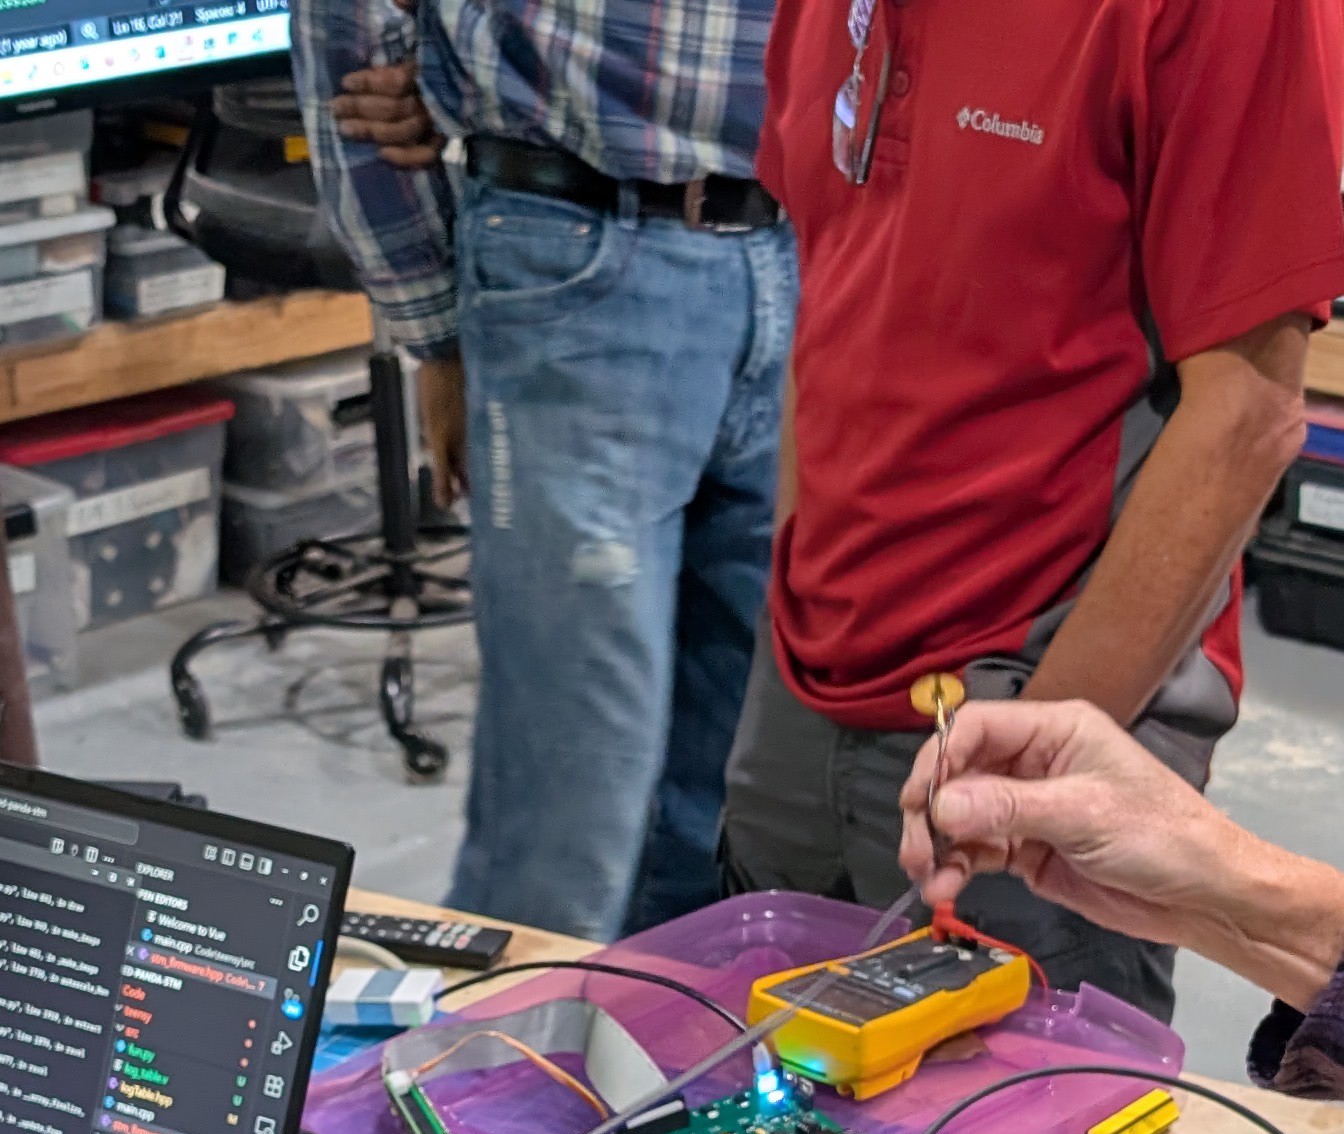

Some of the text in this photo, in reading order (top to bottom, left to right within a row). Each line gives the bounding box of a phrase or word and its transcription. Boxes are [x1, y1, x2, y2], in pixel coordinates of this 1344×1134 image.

[13, 35, 38, 55] year
[39, 30, 67, 49] ago)
[971, 109, 1044, 145] Columbia
[135, 862, 174, 881] EXPLORER
[154, 893, 188, 910] EDITORS
[156, 913, 227, 941] Welcome to Vue
[153, 933, 193, 954] main.cpp
[120, 964, 182, 989] ED-PANDA-STM
[120, 984, 146, 1000] Code
[122, 1005, 152, 1024] teensy
[118, 1080, 174, 1109] logTable.hpp
[115, 1100, 155, 1123] main.cpp
